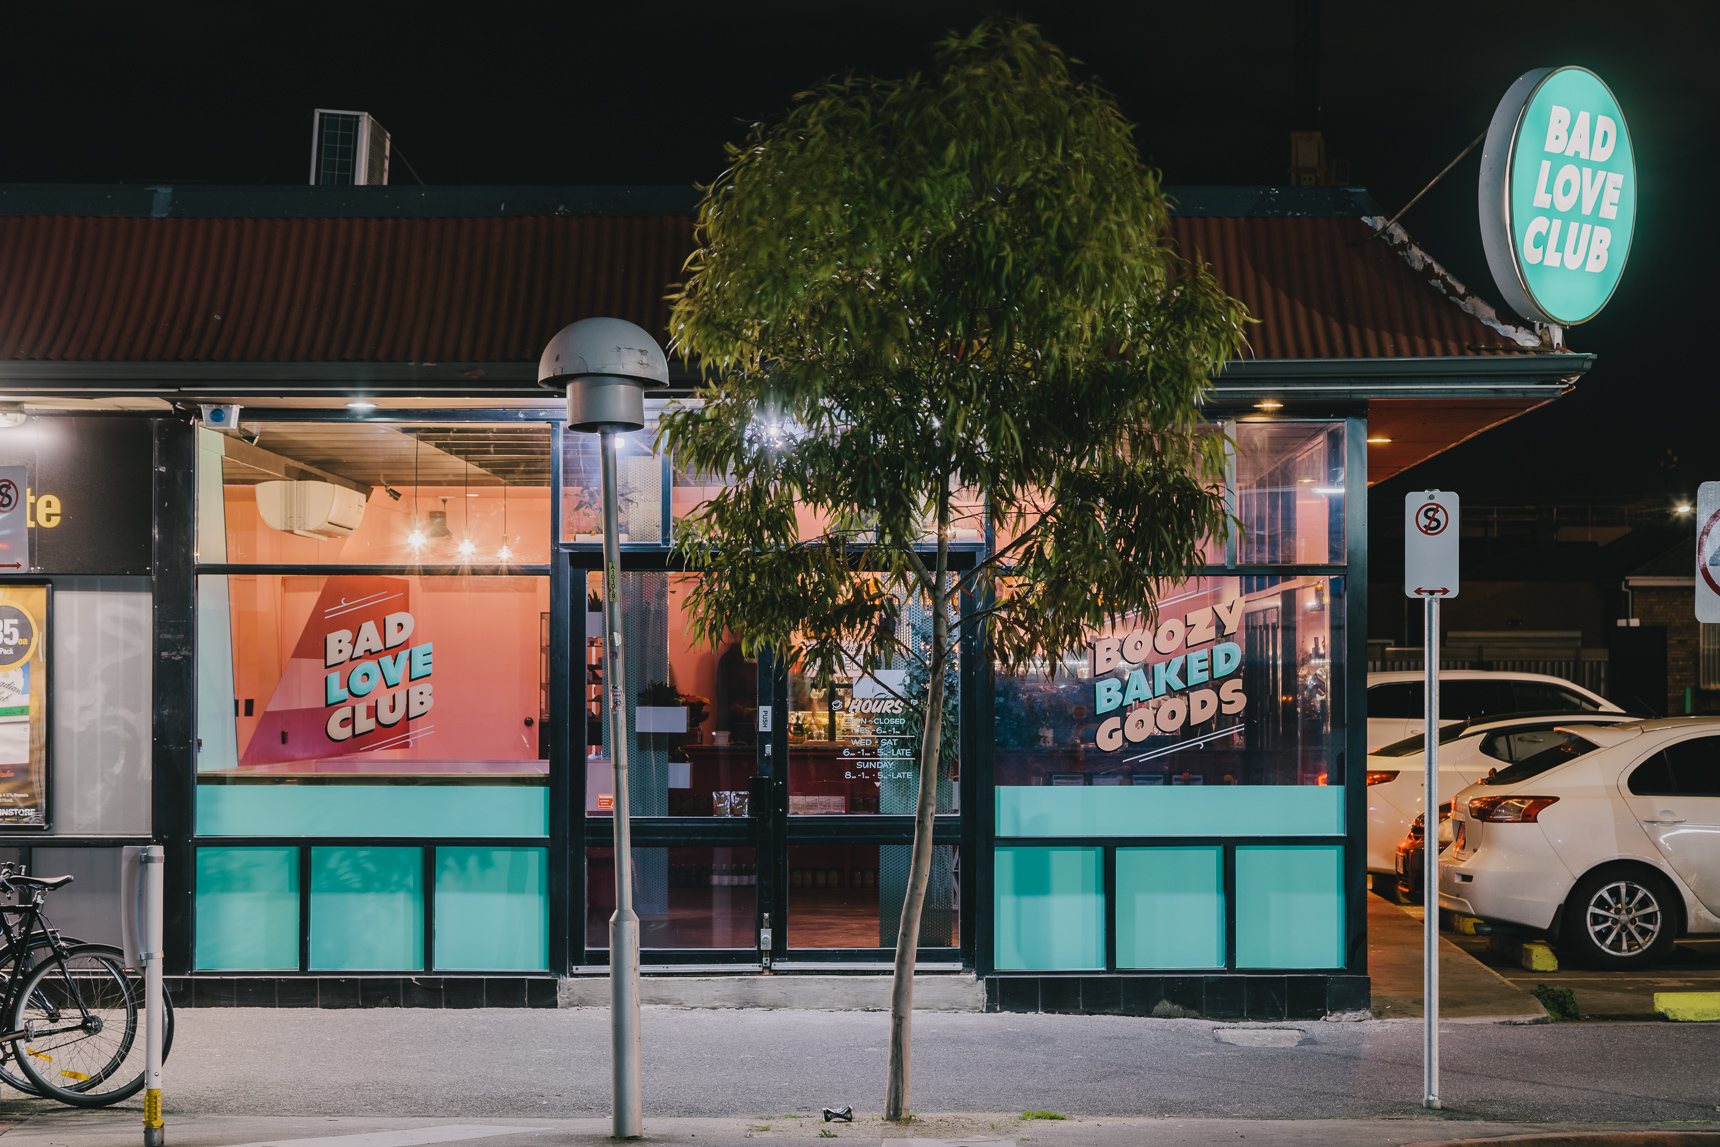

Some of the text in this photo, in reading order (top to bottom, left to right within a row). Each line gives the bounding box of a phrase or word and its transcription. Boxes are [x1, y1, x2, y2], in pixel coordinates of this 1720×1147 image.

[1544, 104, 1617, 163] BAD
[1533, 159, 1624, 220] LOVE
[1523, 215, 1612, 273] CLUB
[324, 611, 415, 669] BAD
[1094, 595, 1247, 677] BOOZY
[325, 642, 433, 708] LOVE
[1094, 641, 1242, 716] BAKED
[325, 683, 434, 743] CLUB
[848, 699, 905, 714] HOURS
[1095, 678, 1247, 752] GOODS
[851, 738, 873, 746] WED
[880, 738, 898, 746] SAT
[856, 761, 893, 769] SUNDAY
